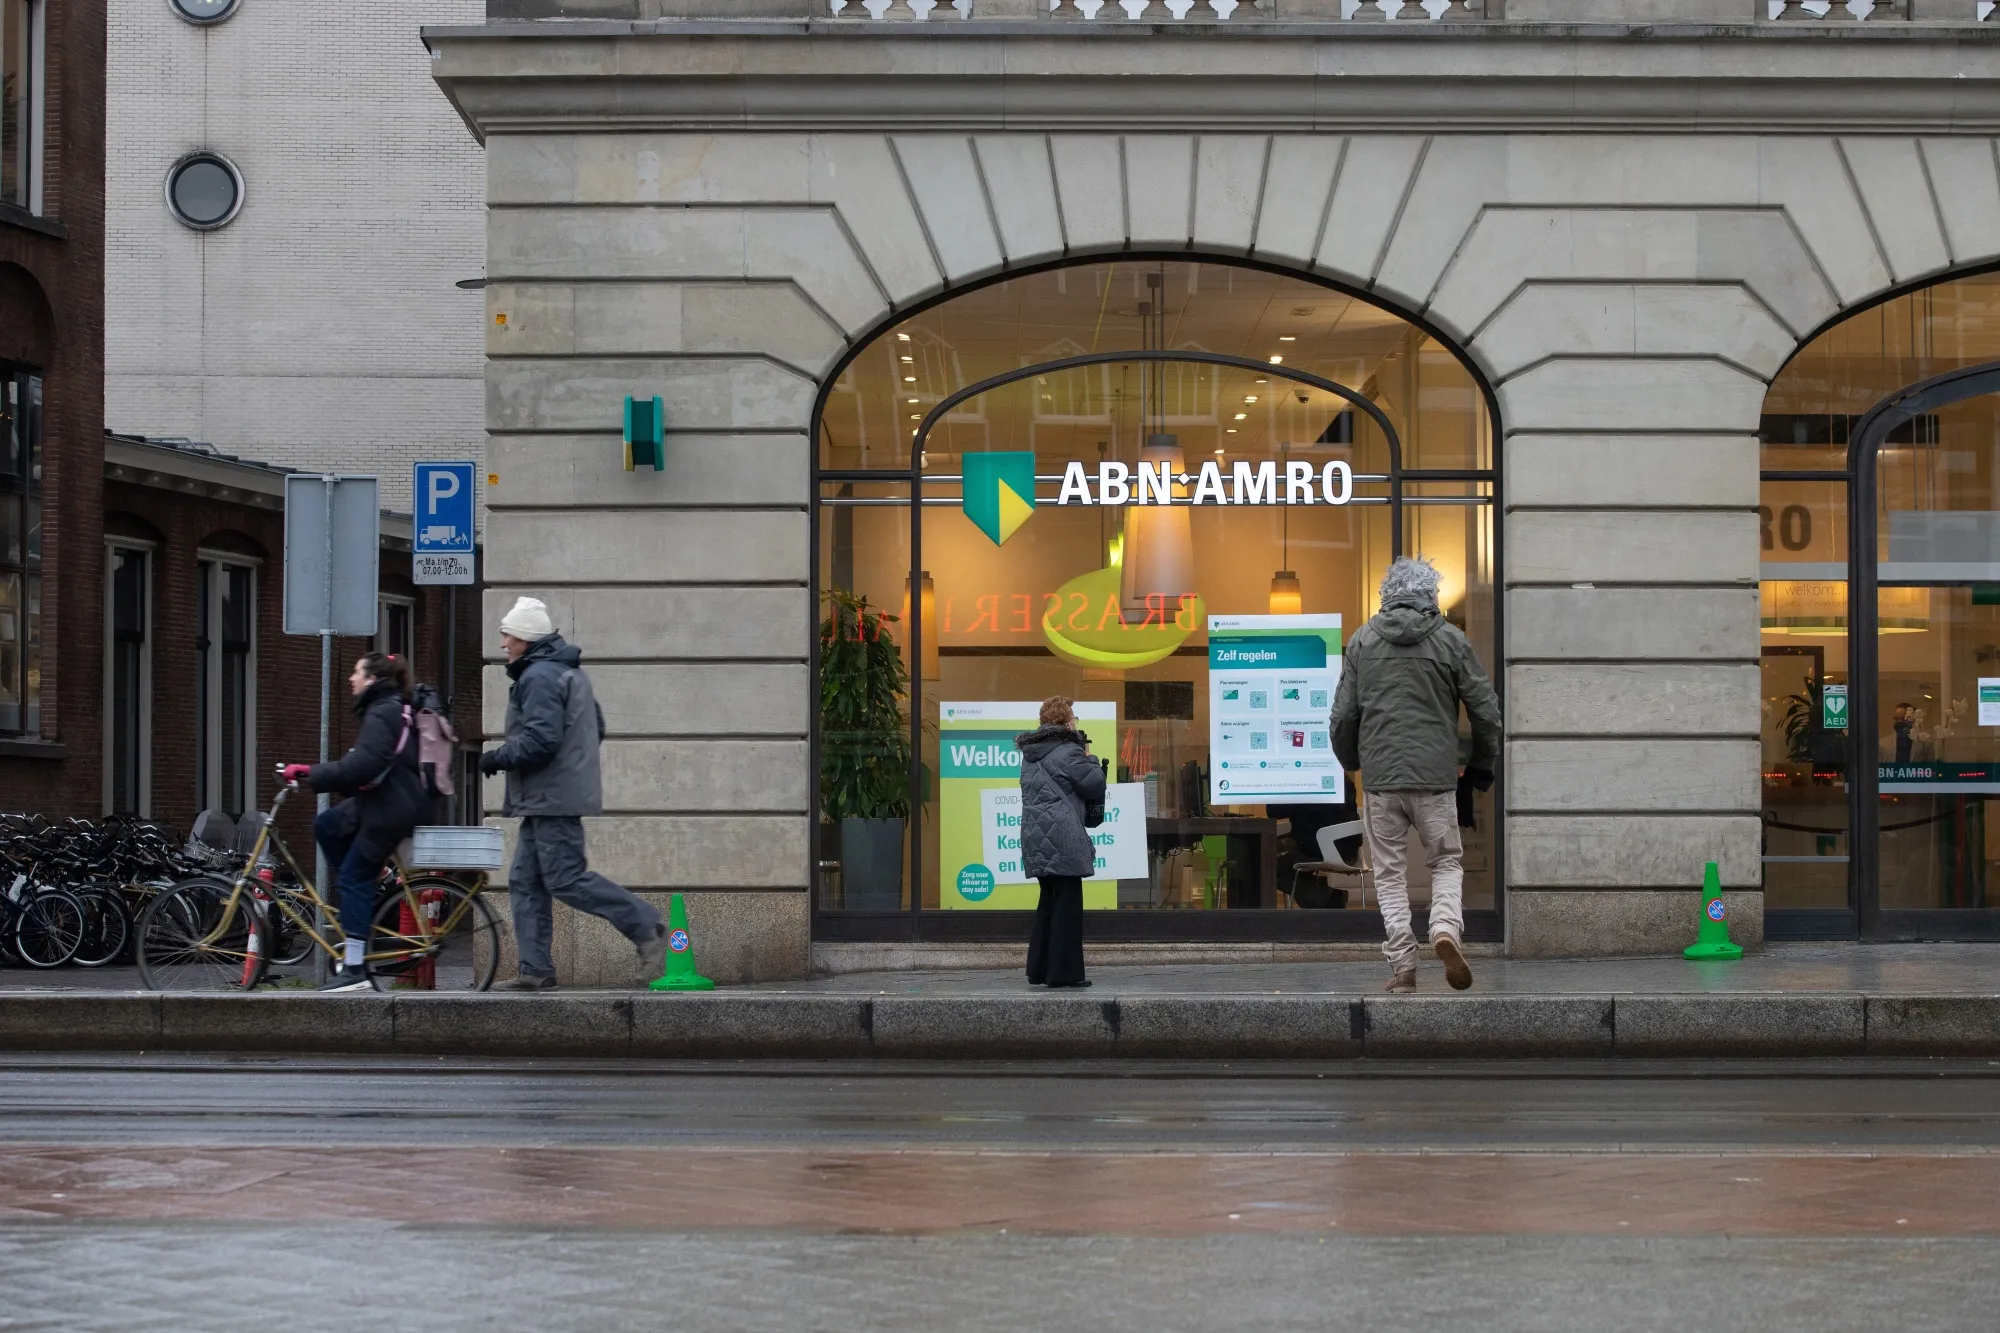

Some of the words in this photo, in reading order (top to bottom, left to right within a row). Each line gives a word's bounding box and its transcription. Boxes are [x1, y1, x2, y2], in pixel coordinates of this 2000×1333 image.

[429, 471, 460, 514] P
[1217, 649, 1237, 661] Zelf
[1238, 649, 1277, 663] regelen
[1825, 717, 1847, 726] AED
[950, 745, 1023, 767] Welko
[998, 861, 1016, 872] en
[961, 871, 975, 879] Zorg
